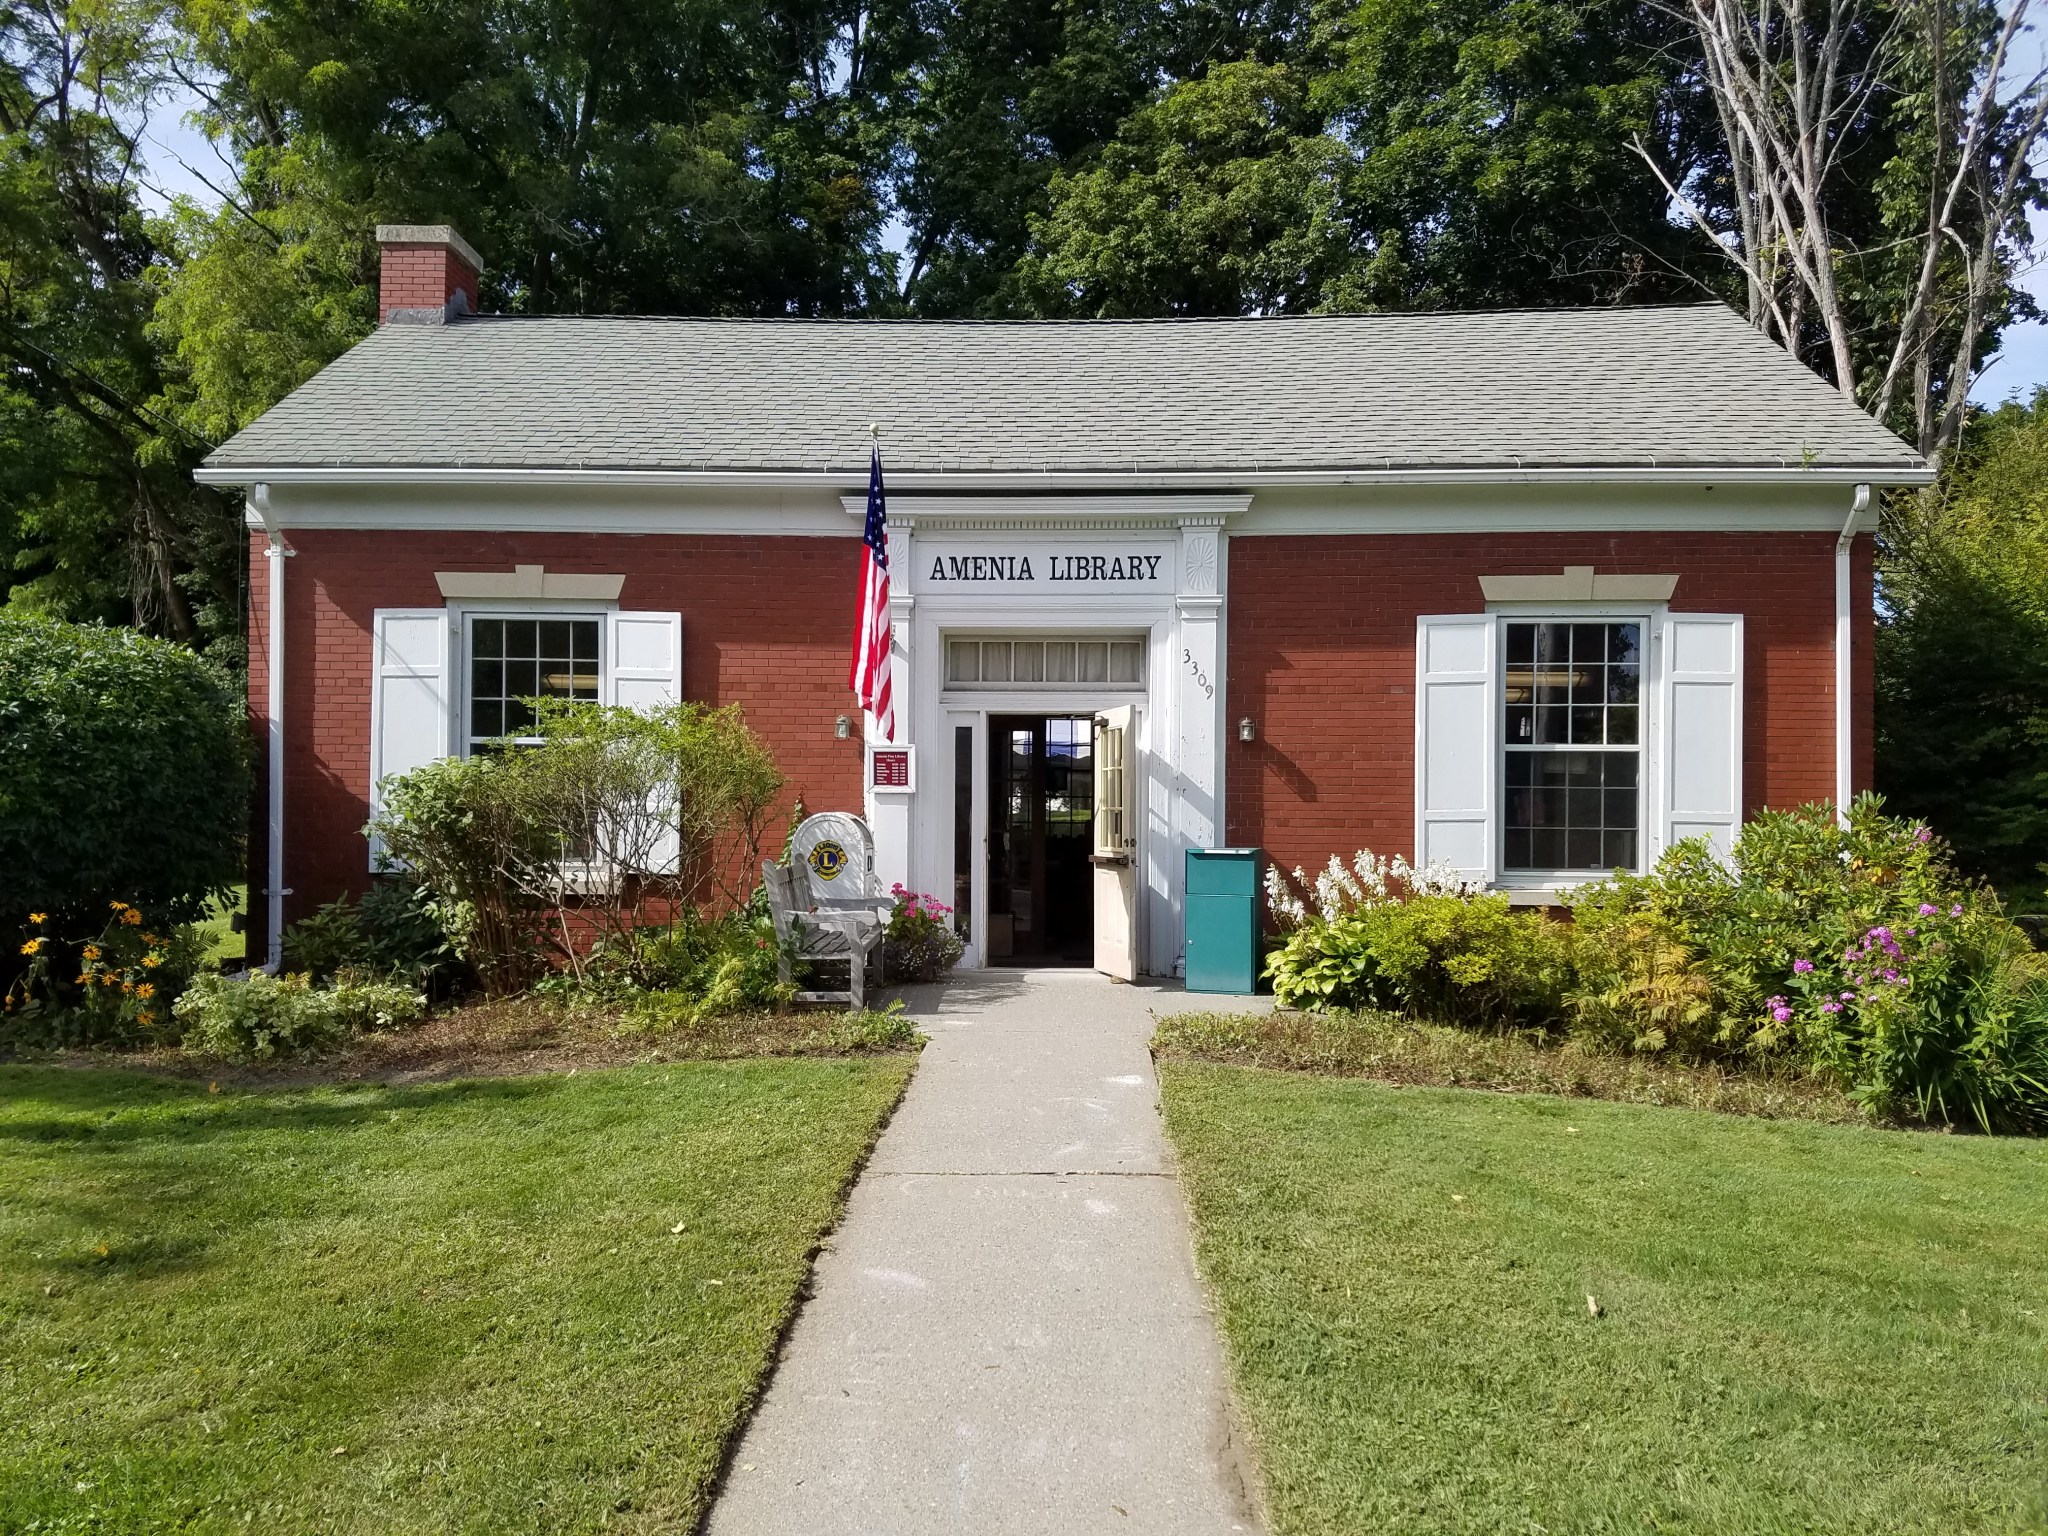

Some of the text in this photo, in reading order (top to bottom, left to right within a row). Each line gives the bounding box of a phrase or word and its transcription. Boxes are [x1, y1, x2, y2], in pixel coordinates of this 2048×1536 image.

[930, 556, 1161, 580] AMENIA LIBRARY
[1183, 648, 1214, 701] 3309
[823, 853, 833, 867] L
